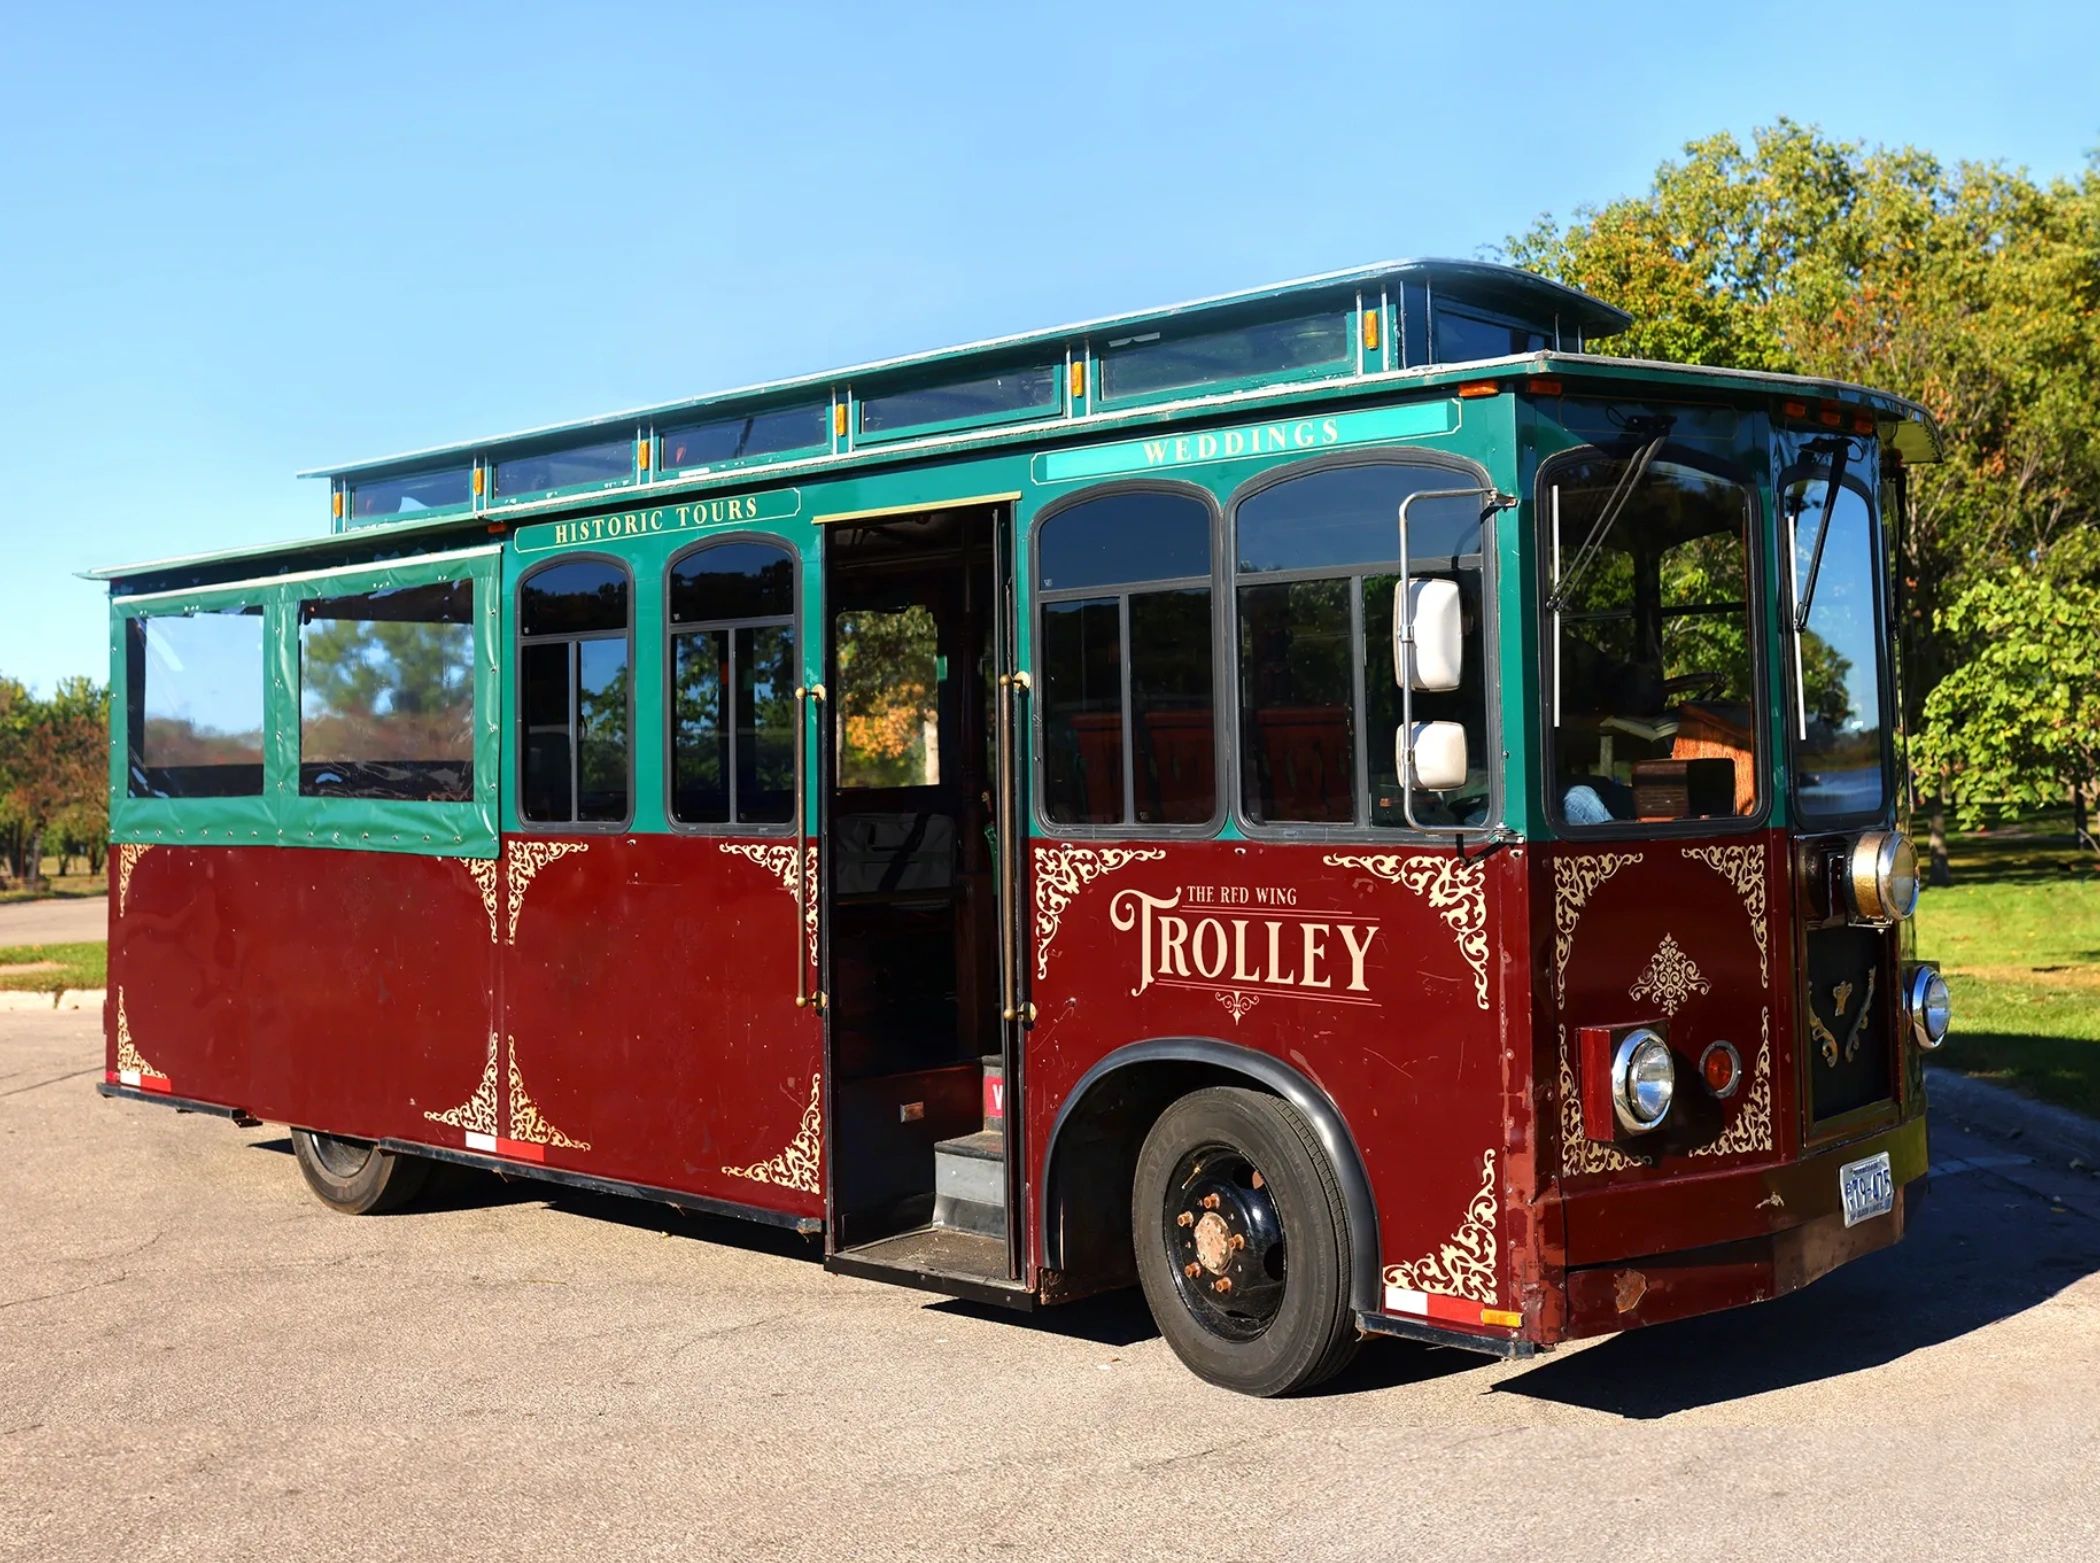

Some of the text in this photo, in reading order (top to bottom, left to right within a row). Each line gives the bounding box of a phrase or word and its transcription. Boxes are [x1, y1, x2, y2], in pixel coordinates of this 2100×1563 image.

[1143, 418, 1338, 465] WEDDINGS
[555, 496, 757, 544] HISTORIC TOURS
[1187, 885, 1297, 906] THE RED WING
[1109, 886, 1380, 997] TROLLEY
